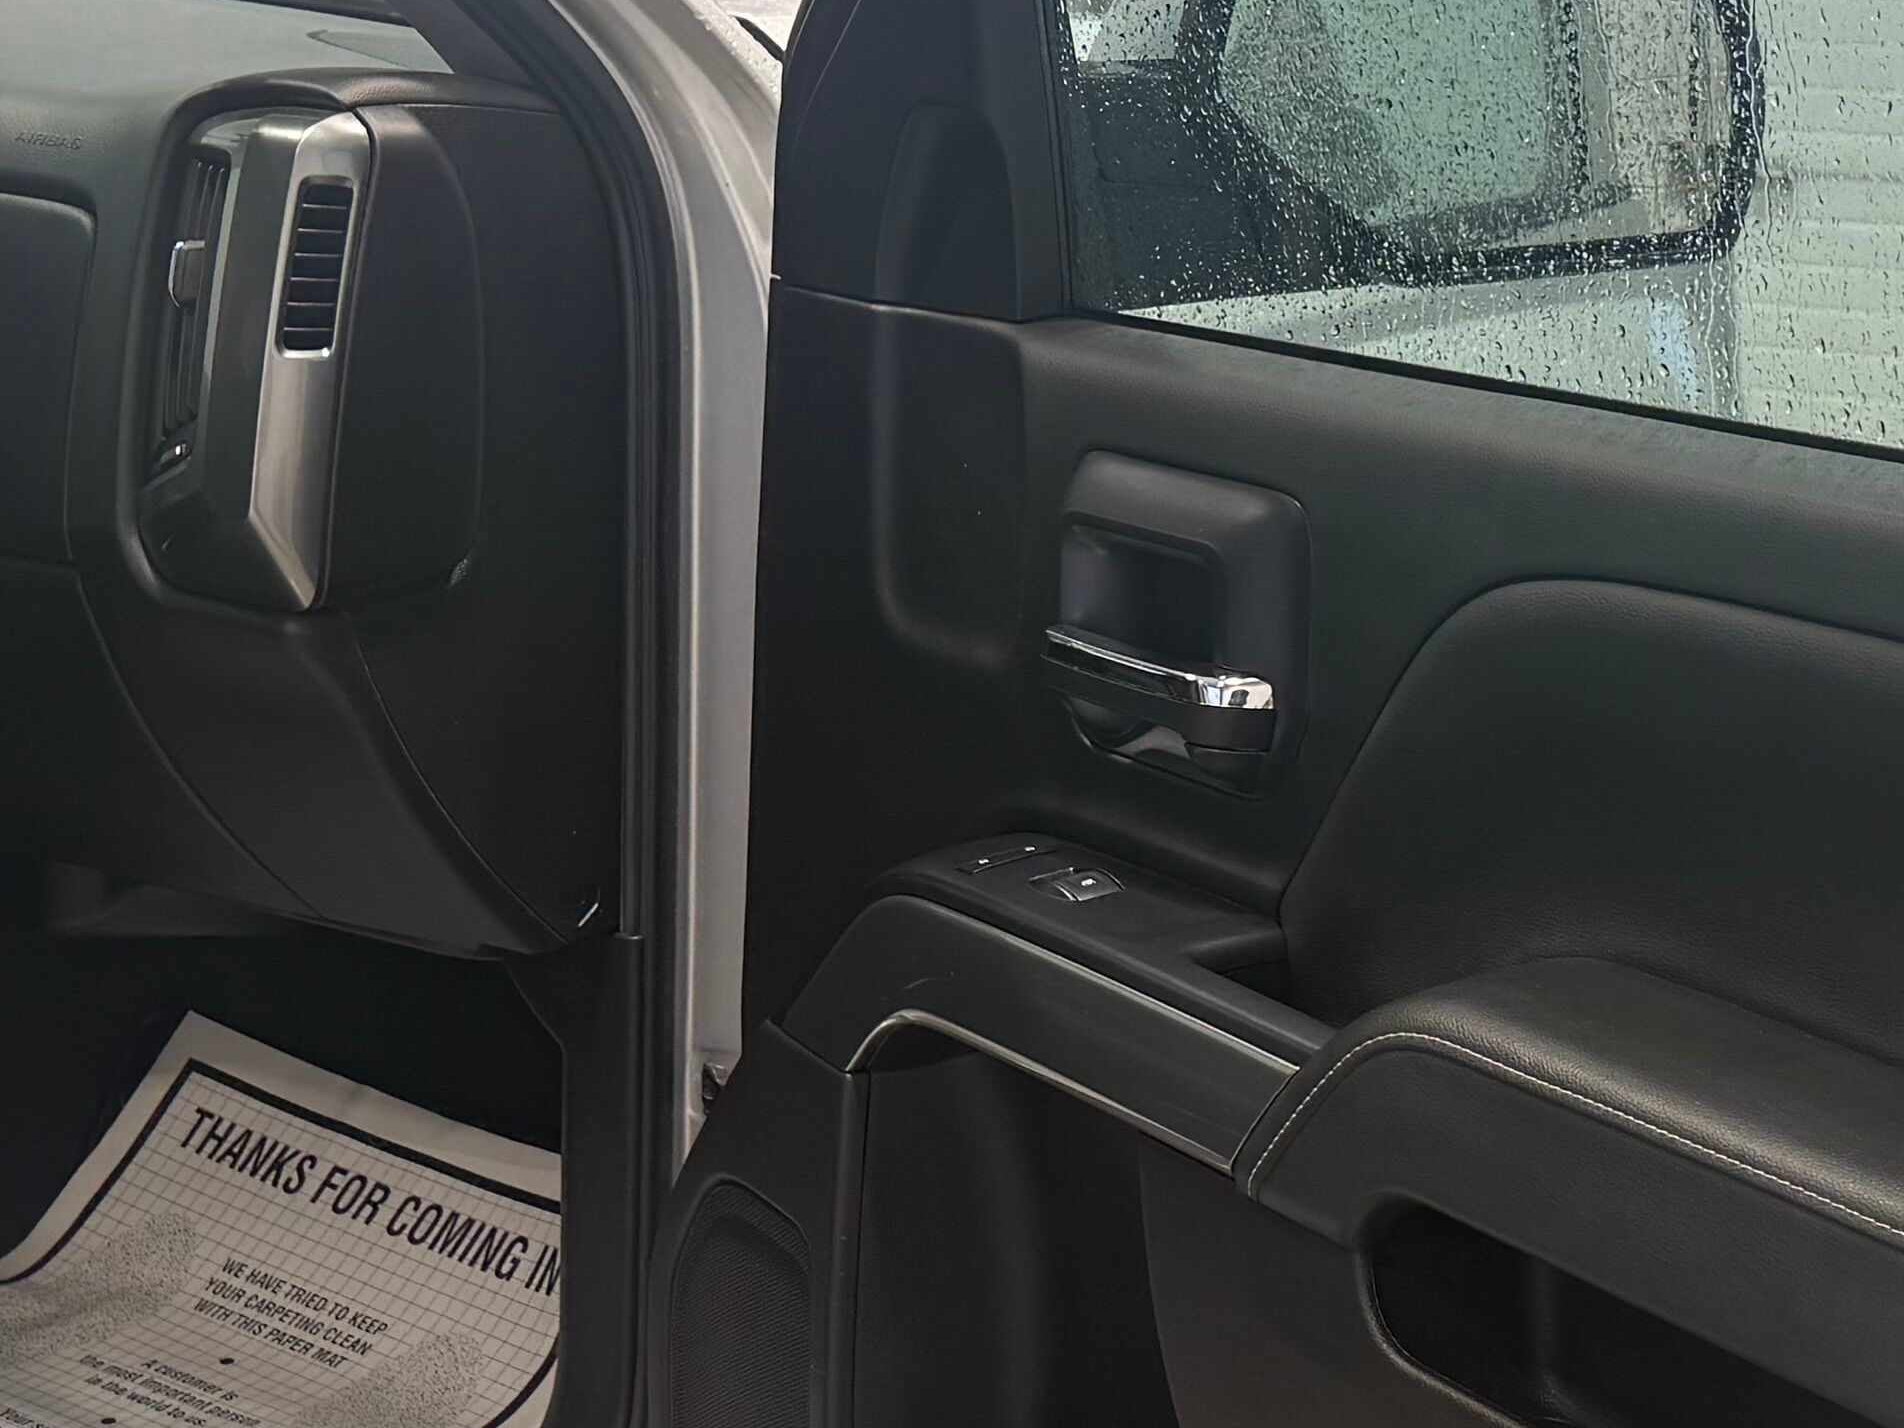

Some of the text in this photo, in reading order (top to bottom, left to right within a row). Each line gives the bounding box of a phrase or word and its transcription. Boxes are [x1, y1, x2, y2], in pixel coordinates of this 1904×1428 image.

[181, 1107, 317, 1194] THANKS
[310, 1165, 391, 1225] FOR
[386, 1196, 529, 1281] COMING
[204, 1277, 373, 1356] YOUR CARPETING CLEAN
[222, 1258, 388, 1335] WE HAVE TRIED TO KEEP
[194, 1298, 348, 1368] WITH THIS PAPER MAT
[126, 1391, 171, 1413] world
[140, 1375, 212, 1412] important
[153, 1365, 222, 1395] customer
